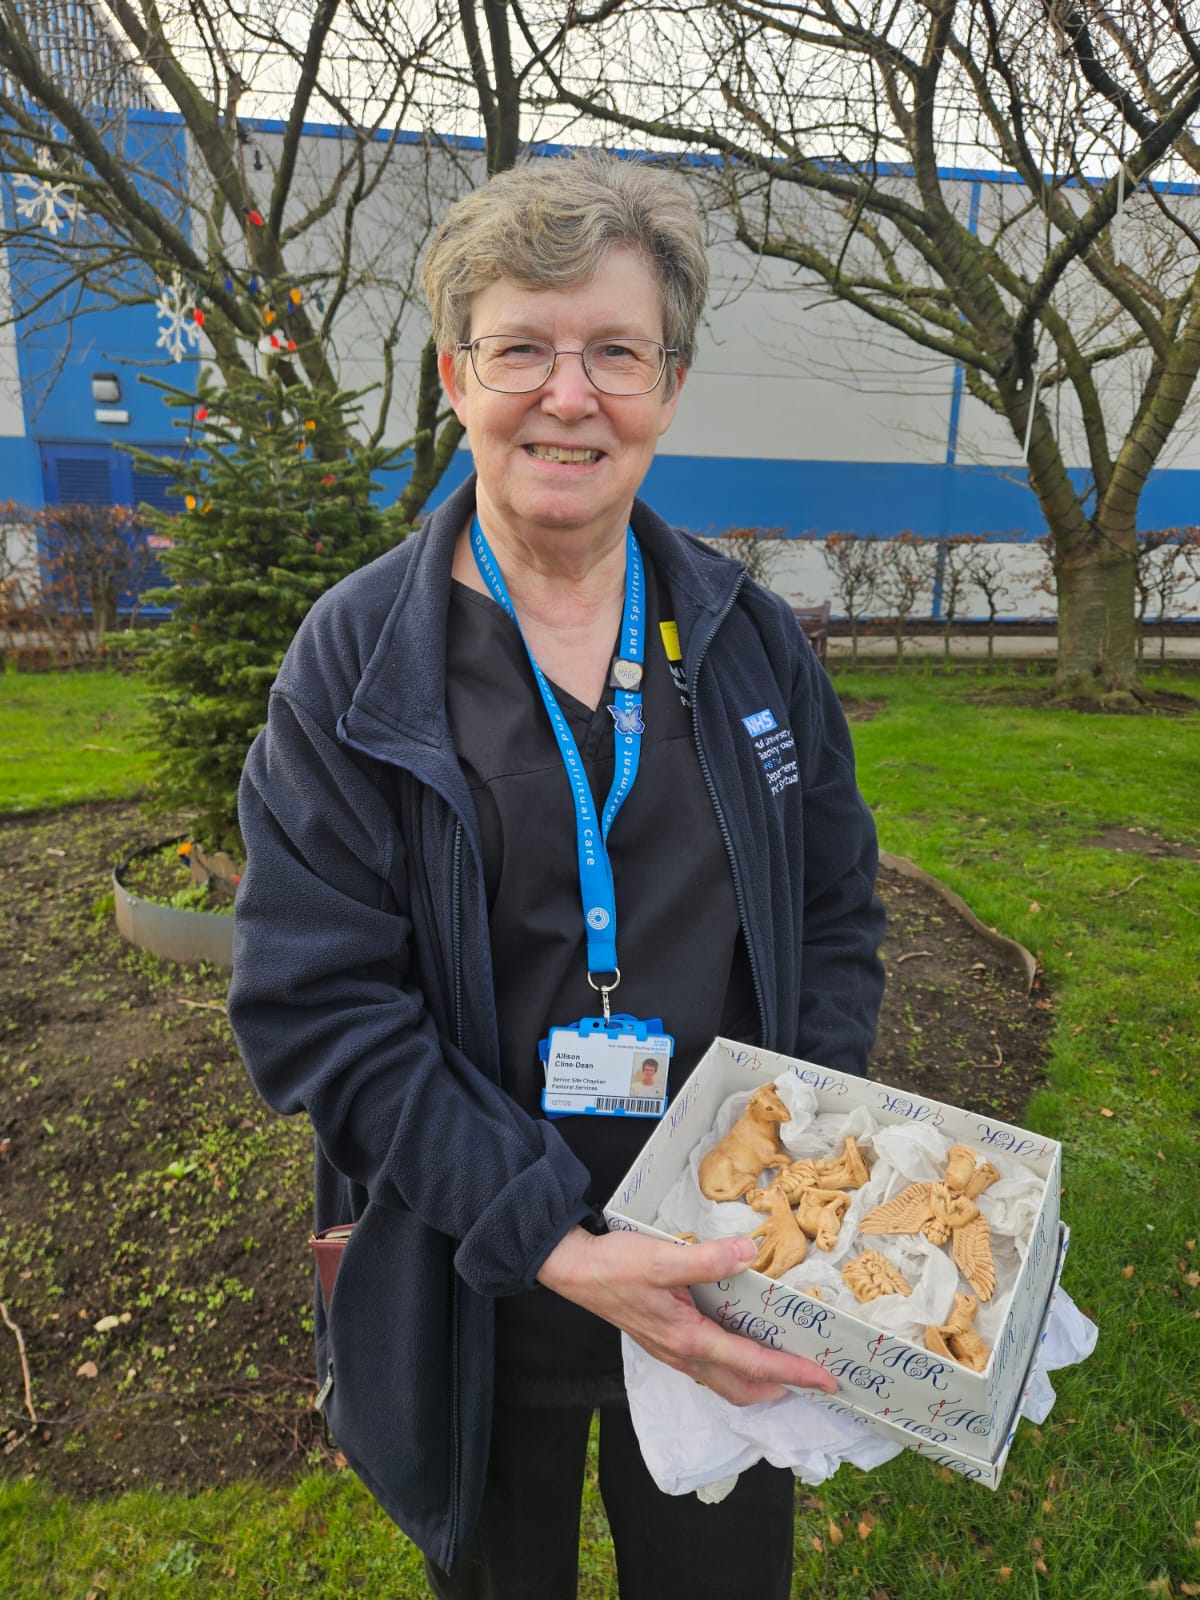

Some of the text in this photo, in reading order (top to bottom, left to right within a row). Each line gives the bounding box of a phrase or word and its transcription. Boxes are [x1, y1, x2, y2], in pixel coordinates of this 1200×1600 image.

[630, 557, 640, 621] Spiritual
[629, 628, 638, 655] and
[475, 535, 514, 619] Department
[554, 714, 570, 742] and
[566, 749, 592, 821] Spiritual
[583, 829, 596, 866] Care
[743, 710, 774, 734] NHS
